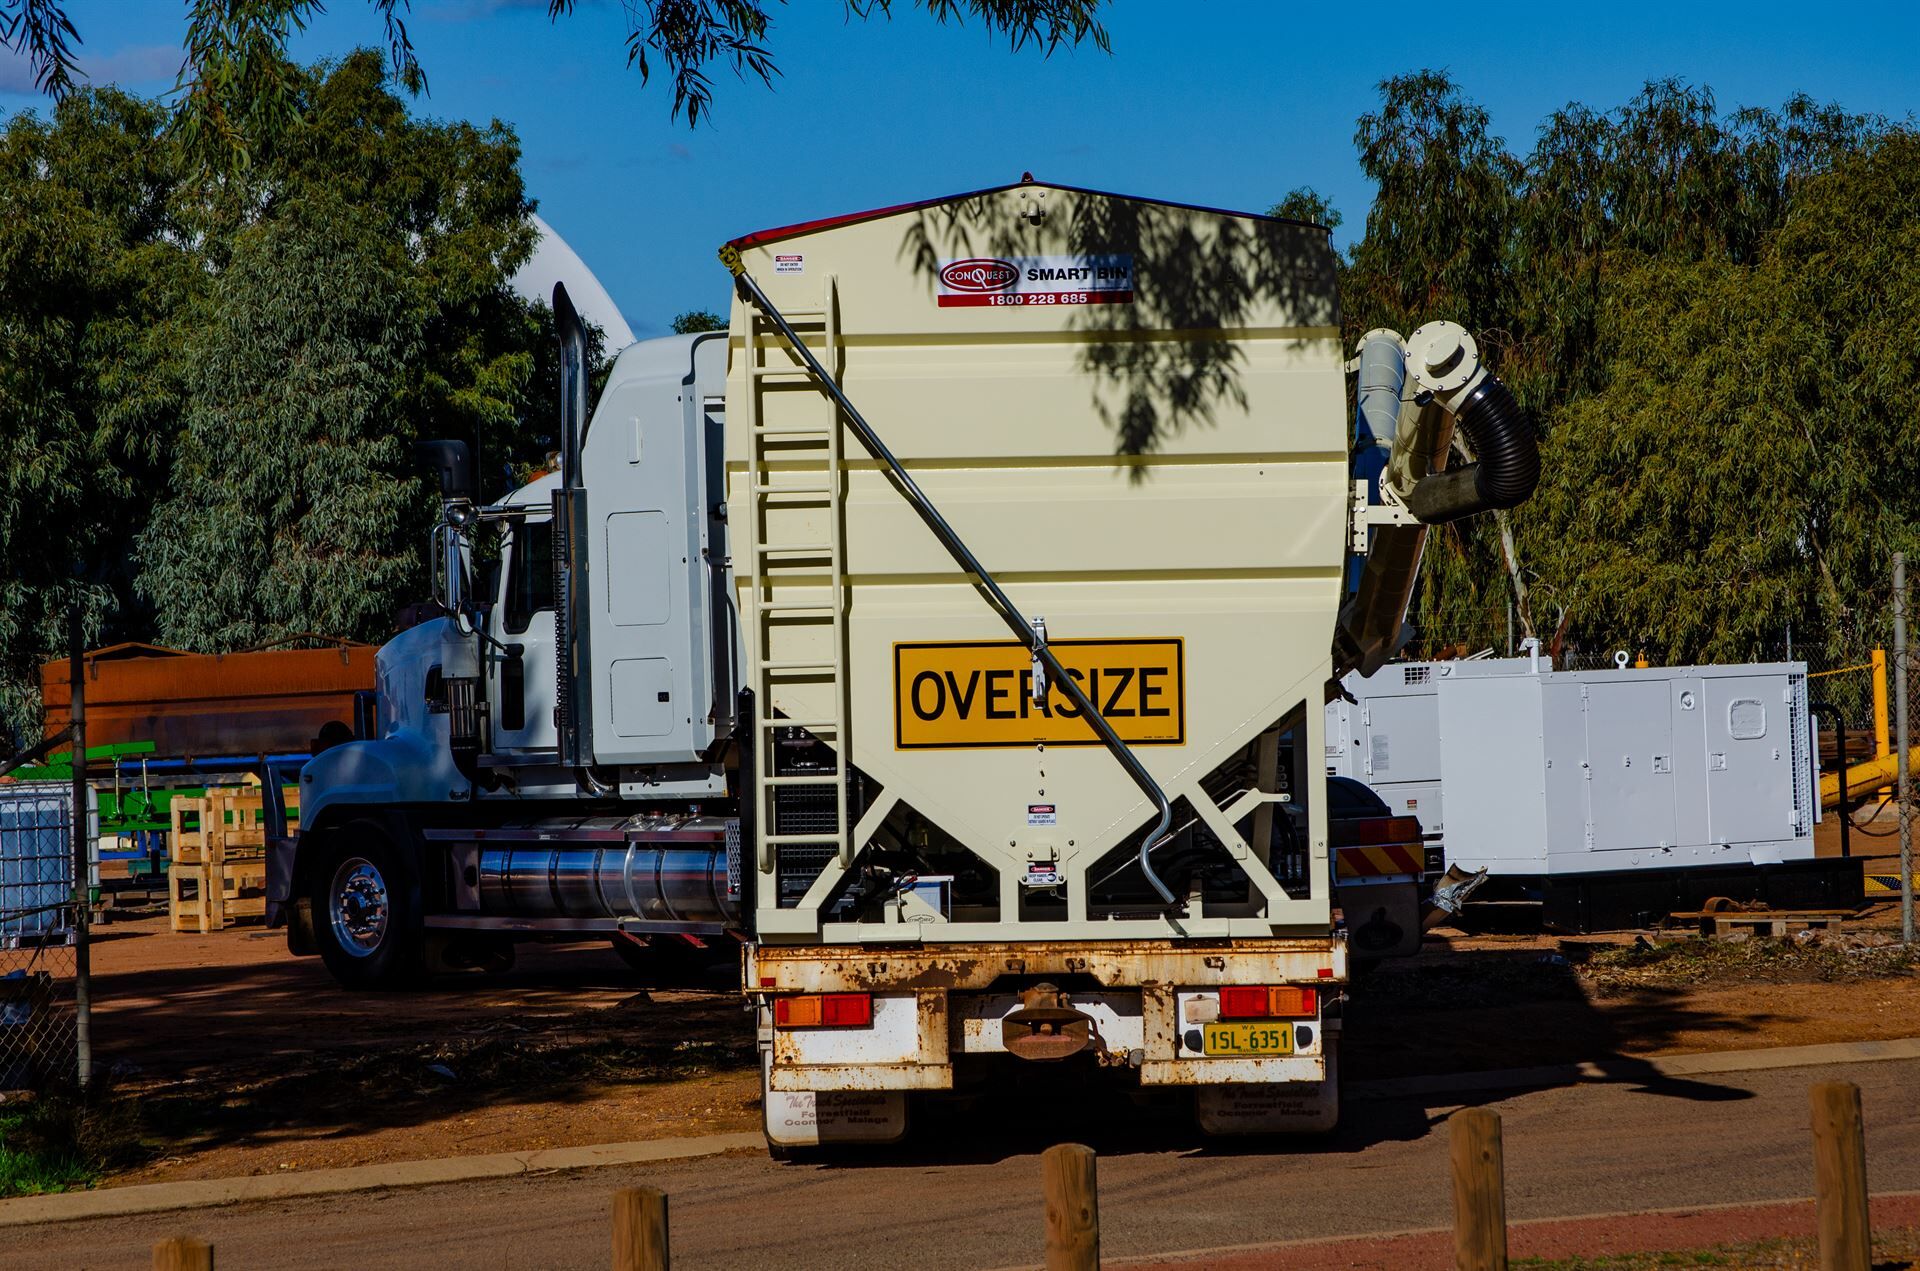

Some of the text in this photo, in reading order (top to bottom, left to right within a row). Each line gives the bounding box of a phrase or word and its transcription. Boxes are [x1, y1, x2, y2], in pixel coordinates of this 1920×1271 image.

[947, 268, 1011, 289] CONQUEST
[1027, 267, 1128, 281] SMART BIN
[989, 293, 1088, 305] 1800 228 685
[911, 667, 1170, 721] OVERSIZE
